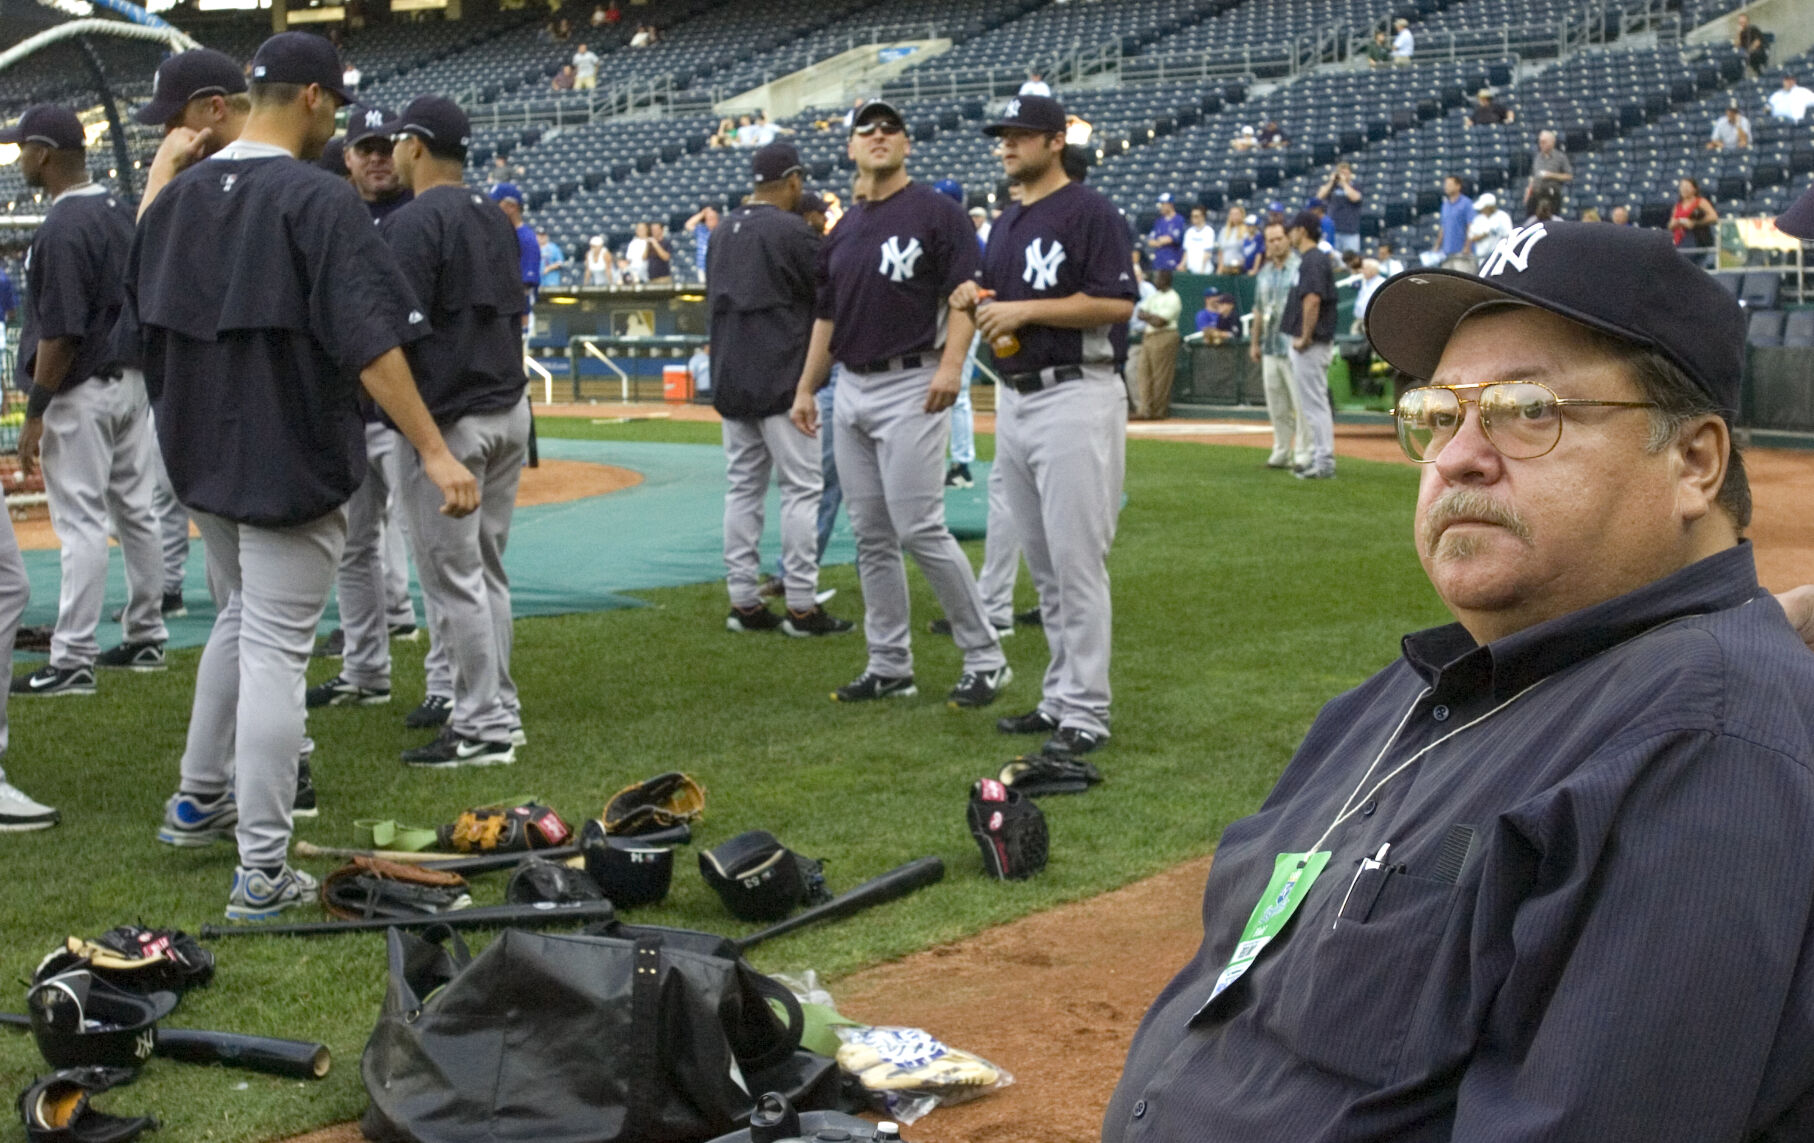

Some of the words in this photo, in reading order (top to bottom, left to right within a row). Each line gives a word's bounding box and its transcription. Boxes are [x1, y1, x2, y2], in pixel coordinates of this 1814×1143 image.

[879, 236, 923, 281] NY
[1022, 237, 1066, 290] NY
[1479, 222, 1548, 278] NY
[135, 1028, 154, 1058] NY
